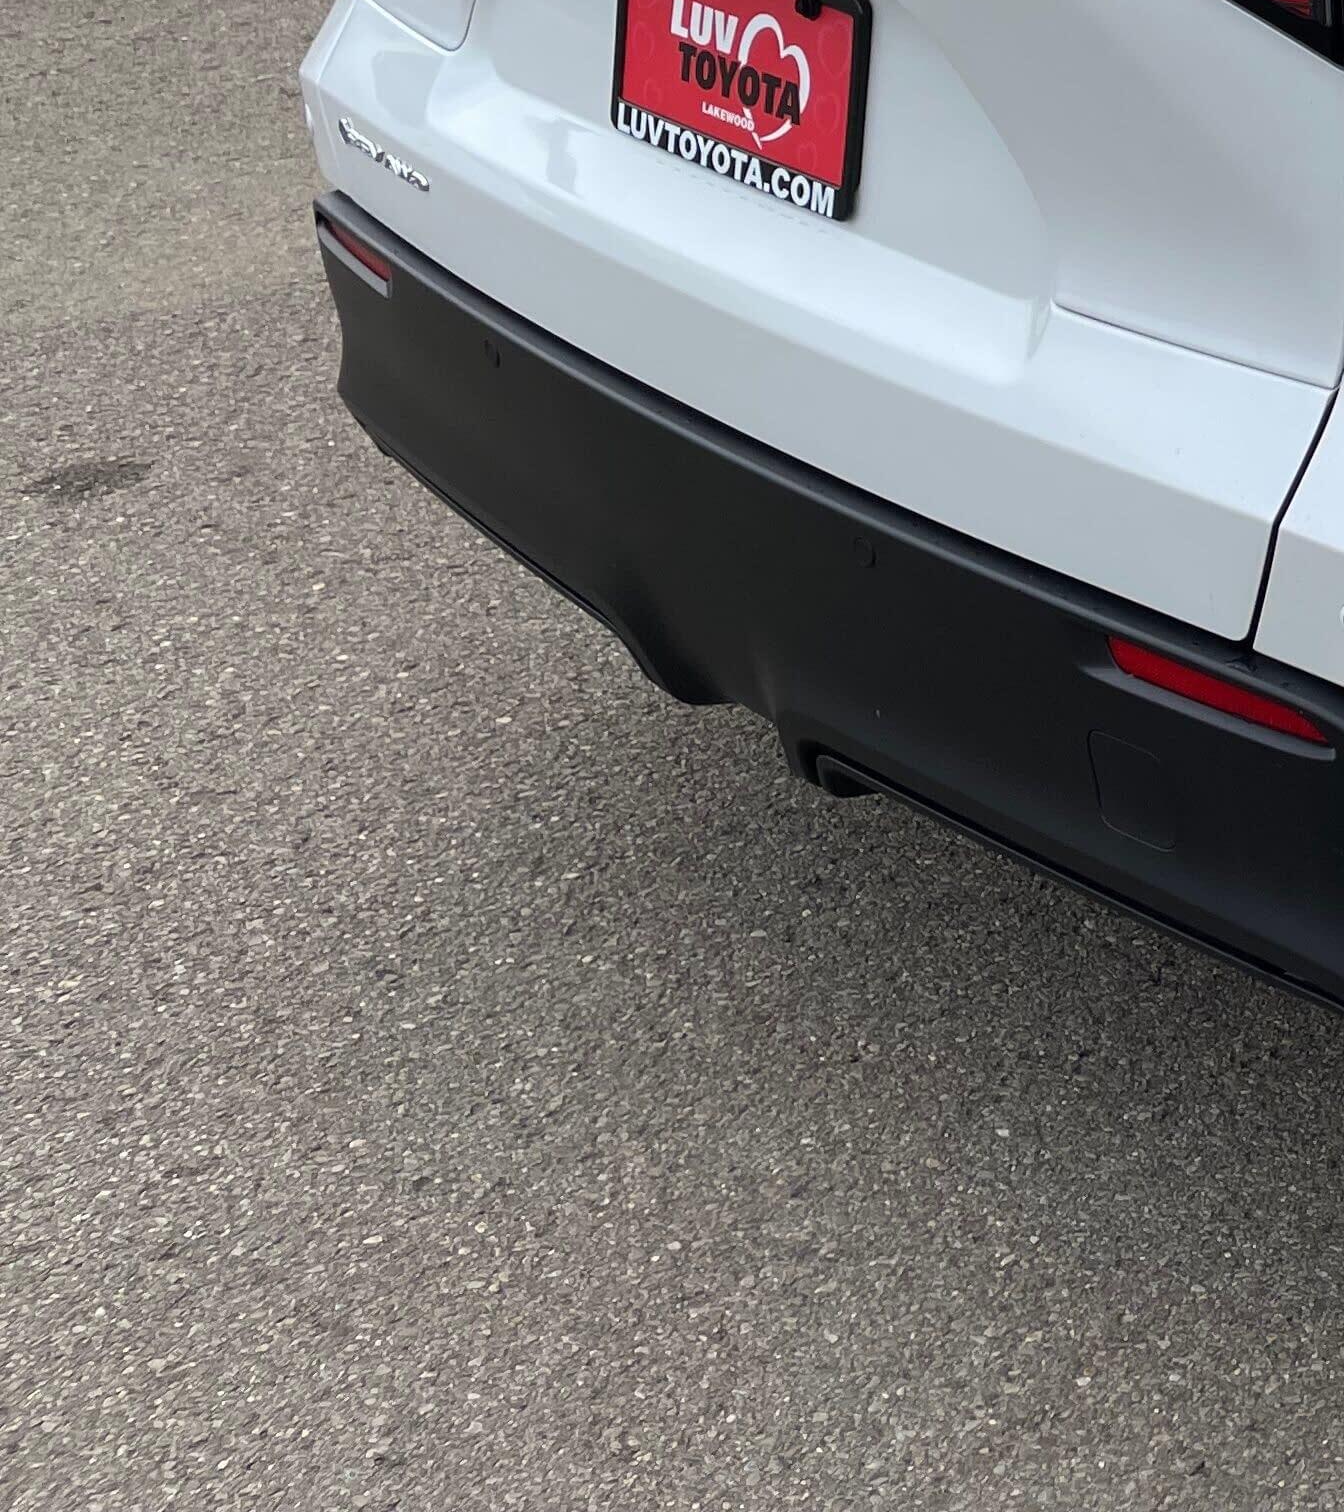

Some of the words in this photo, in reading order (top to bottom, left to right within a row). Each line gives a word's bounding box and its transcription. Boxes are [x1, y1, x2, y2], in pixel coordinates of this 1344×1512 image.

[678, 41, 802, 126] TOYOTA
[702, 101, 755, 132] LAKEWOOD
[616, 102, 836, 218] LUVTOYOTA.COM
